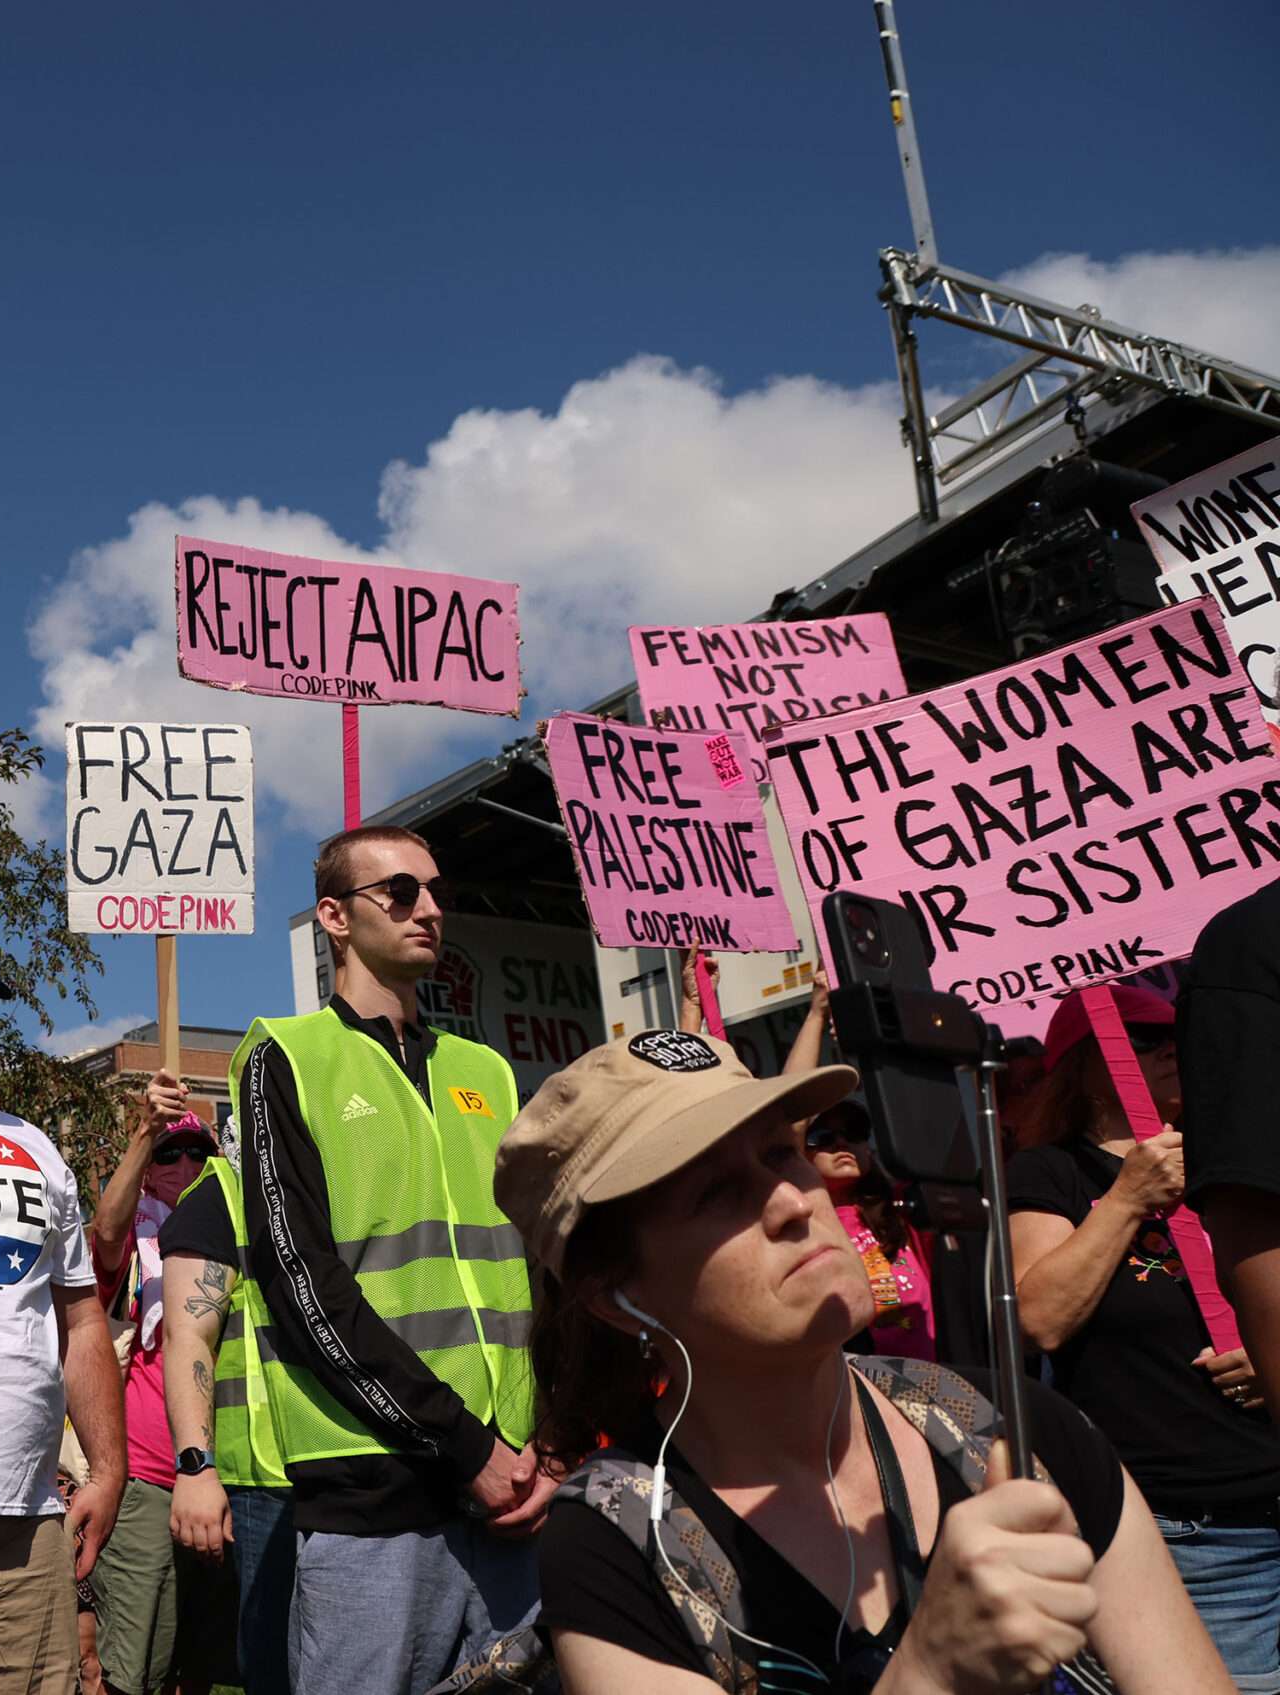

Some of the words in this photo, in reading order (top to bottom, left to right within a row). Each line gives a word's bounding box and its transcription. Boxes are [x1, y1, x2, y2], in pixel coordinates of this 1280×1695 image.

[1141, 461, 1280, 563] WOME
[185, 550, 340, 673] REJECT
[345, 577, 505, 683] AIPAC
[640, 622, 871, 667] FEMINISM
[281, 672, 384, 701] CODEPINK
[713, 663, 805, 700] NOT
[766, 720, 935, 816] THE
[920, 608, 1234, 764] WOMEN
[75, 724, 245, 802] FREE
[573, 722, 702, 810] FREE
[802, 814, 868, 894] OF
[894, 743, 1135, 872] GAZA
[1131, 689, 1275, 795] ARE
[71, 806, 248, 885] GAZA
[566, 799, 775, 899] PALESTINE
[97, 895, 237, 931] CODEPINK
[626, 908, 739, 949] CODEPINK
[949, 936, 1165, 1010] CODEPINK
[505, 1014, 592, 1066] END
[631, 1030, 689, 1054] KPFK
[342, 1106, 379, 1123] adidas
[458, 1090, 483, 1110] 15
[259, 1148, 273, 1185] BANDES
[270, 1193, 281, 1213] AUX
[281, 1247, 294, 1262] LA
[314, 1323, 333, 1344] DEN
[327, 1341, 343, 1361] MIT
[384, 1405, 400, 1423] DIE
